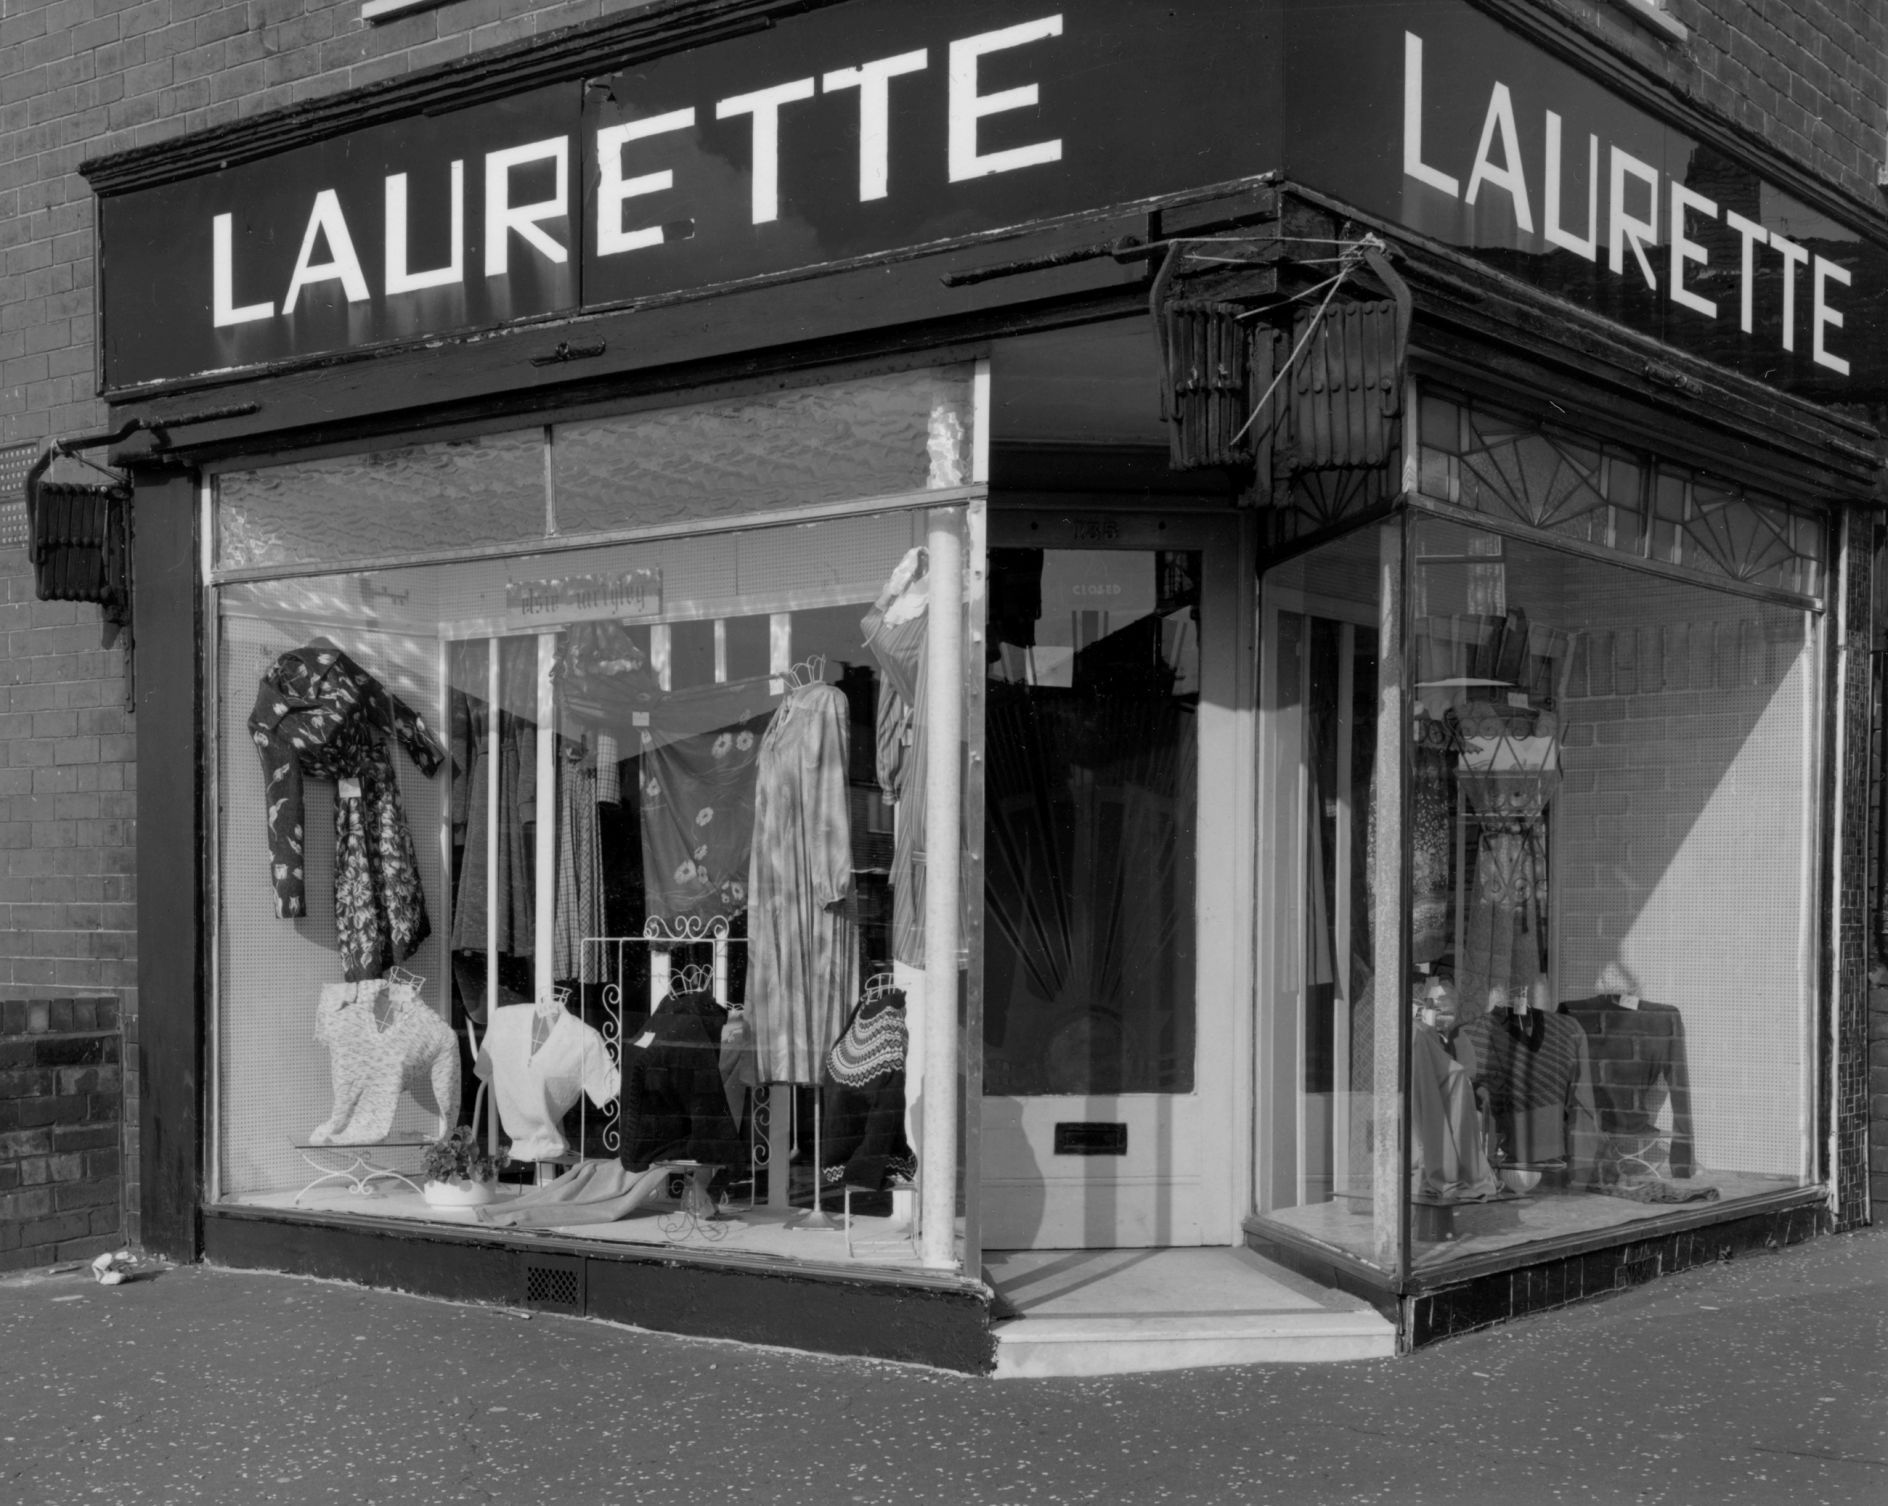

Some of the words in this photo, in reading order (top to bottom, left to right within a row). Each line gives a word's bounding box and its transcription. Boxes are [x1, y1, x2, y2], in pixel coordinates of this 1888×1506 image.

[213, 13, 1063, 327] LAURETTE
[1404, 30, 1851, 376] LAURETTE
[1072, 584, 1121, 595] CLOSED
